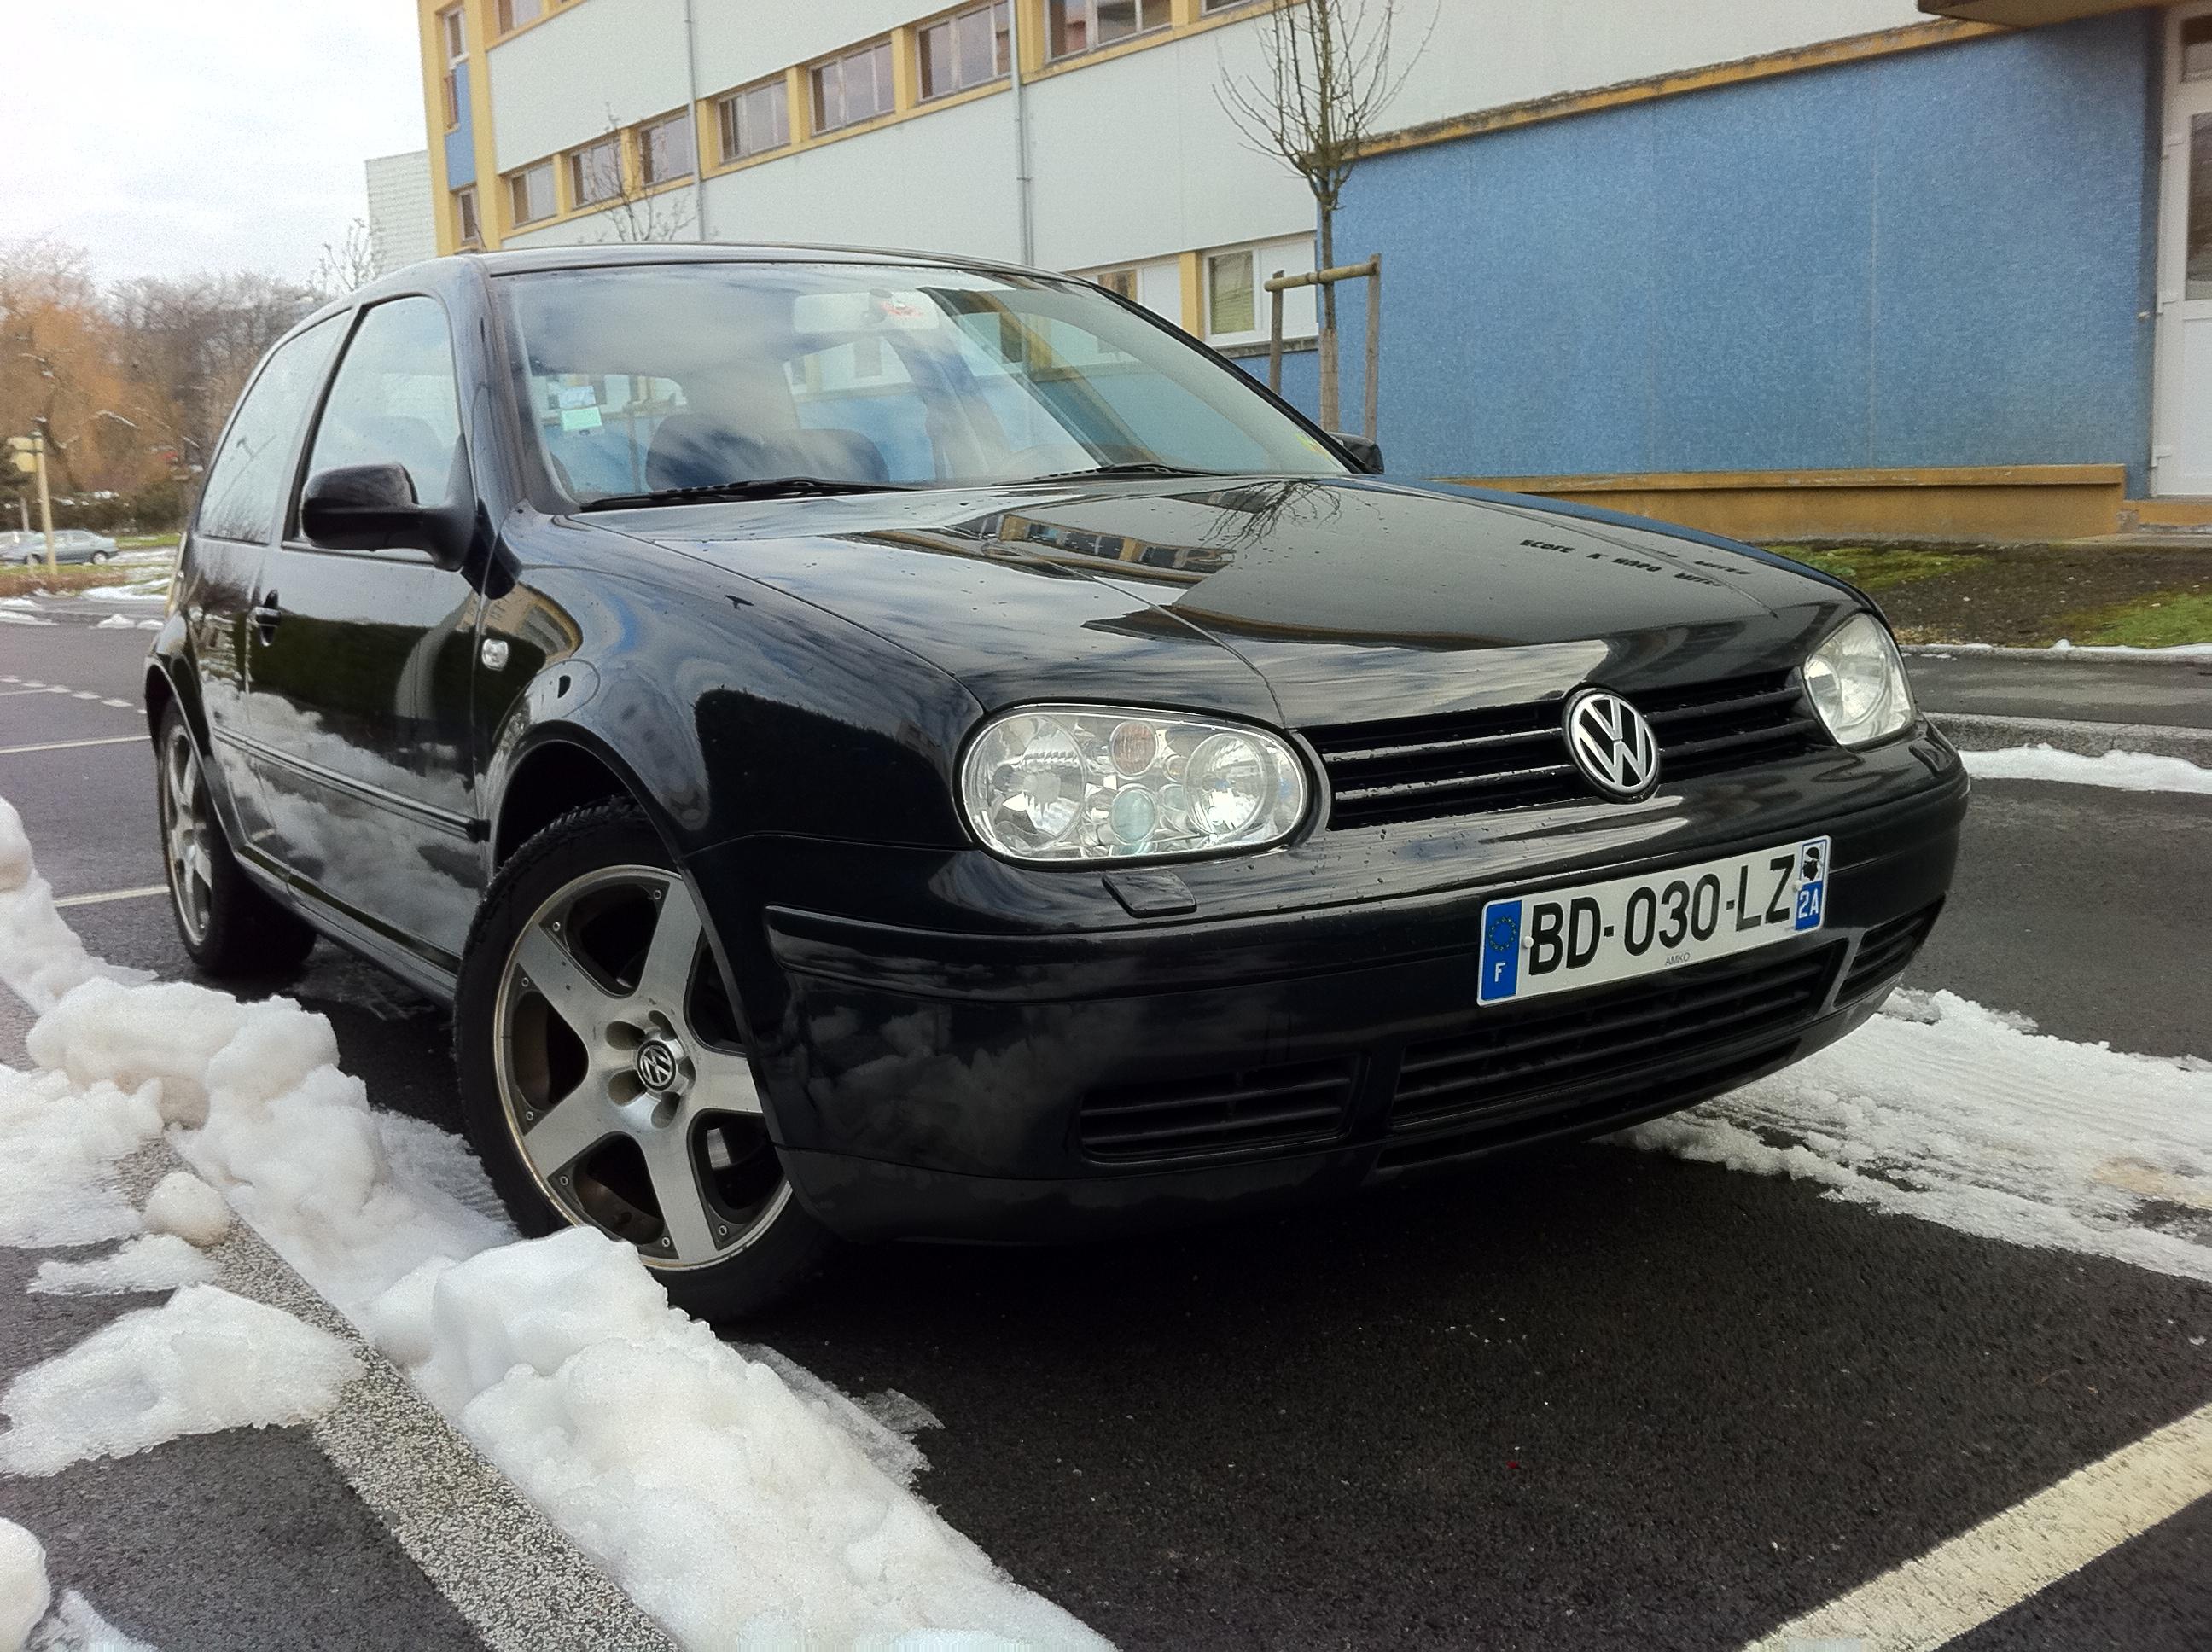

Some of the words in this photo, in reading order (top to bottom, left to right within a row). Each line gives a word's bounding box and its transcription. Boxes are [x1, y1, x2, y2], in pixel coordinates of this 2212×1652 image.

[1571, 694, 1654, 794] VW
[1528, 854, 1795, 976] BD-030-LZ
[1798, 887, 1819, 919] 2A
[1494, 962, 1506, 982] F
[1664, 951, 1691, 967] AMKO
